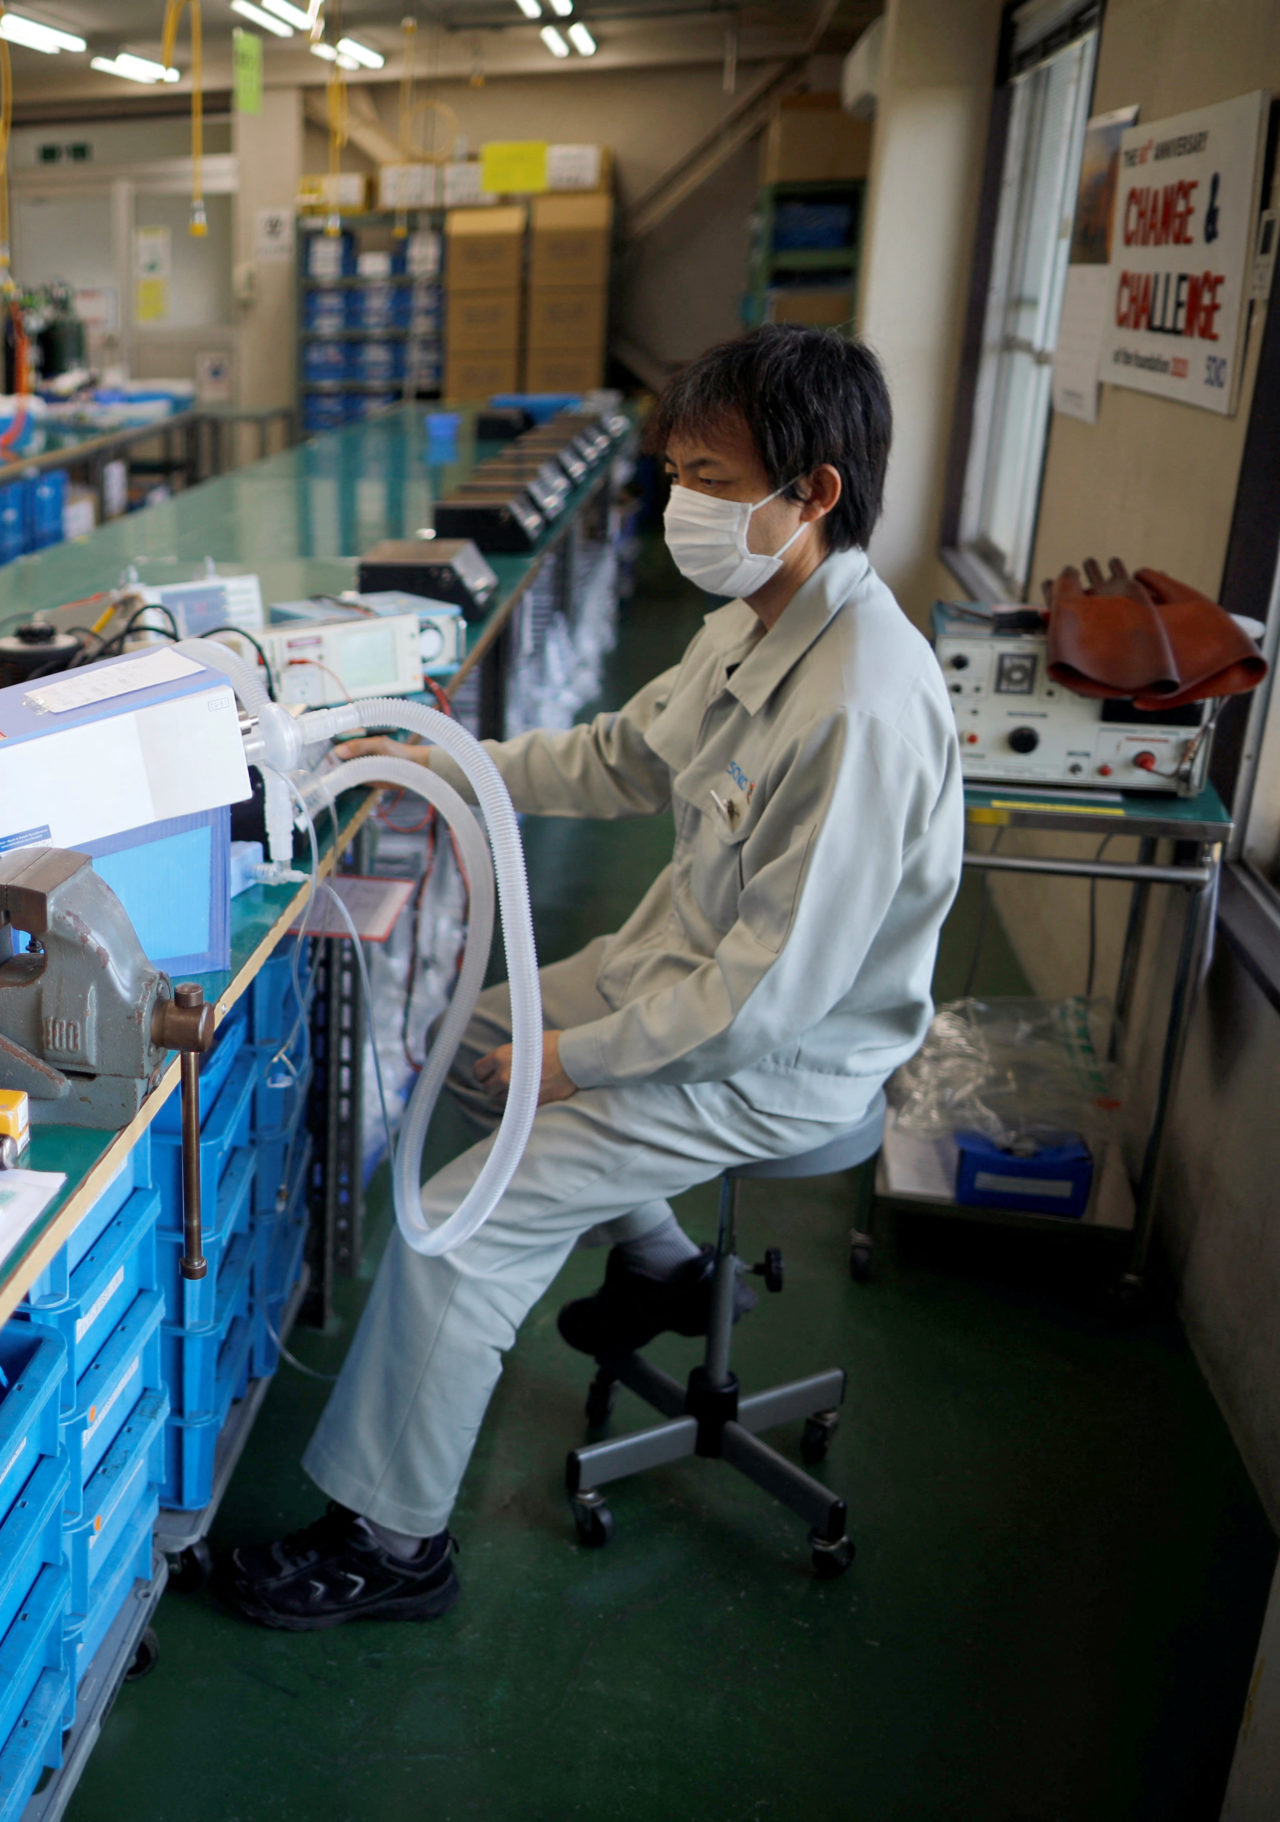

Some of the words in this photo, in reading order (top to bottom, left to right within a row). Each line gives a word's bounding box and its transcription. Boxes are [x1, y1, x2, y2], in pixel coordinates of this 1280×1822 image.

[1124, 180, 1199, 246] CHANGE
[1116, 270, 1225, 341] CHALLENGE
[44, 1015, 81, 1053] 100
